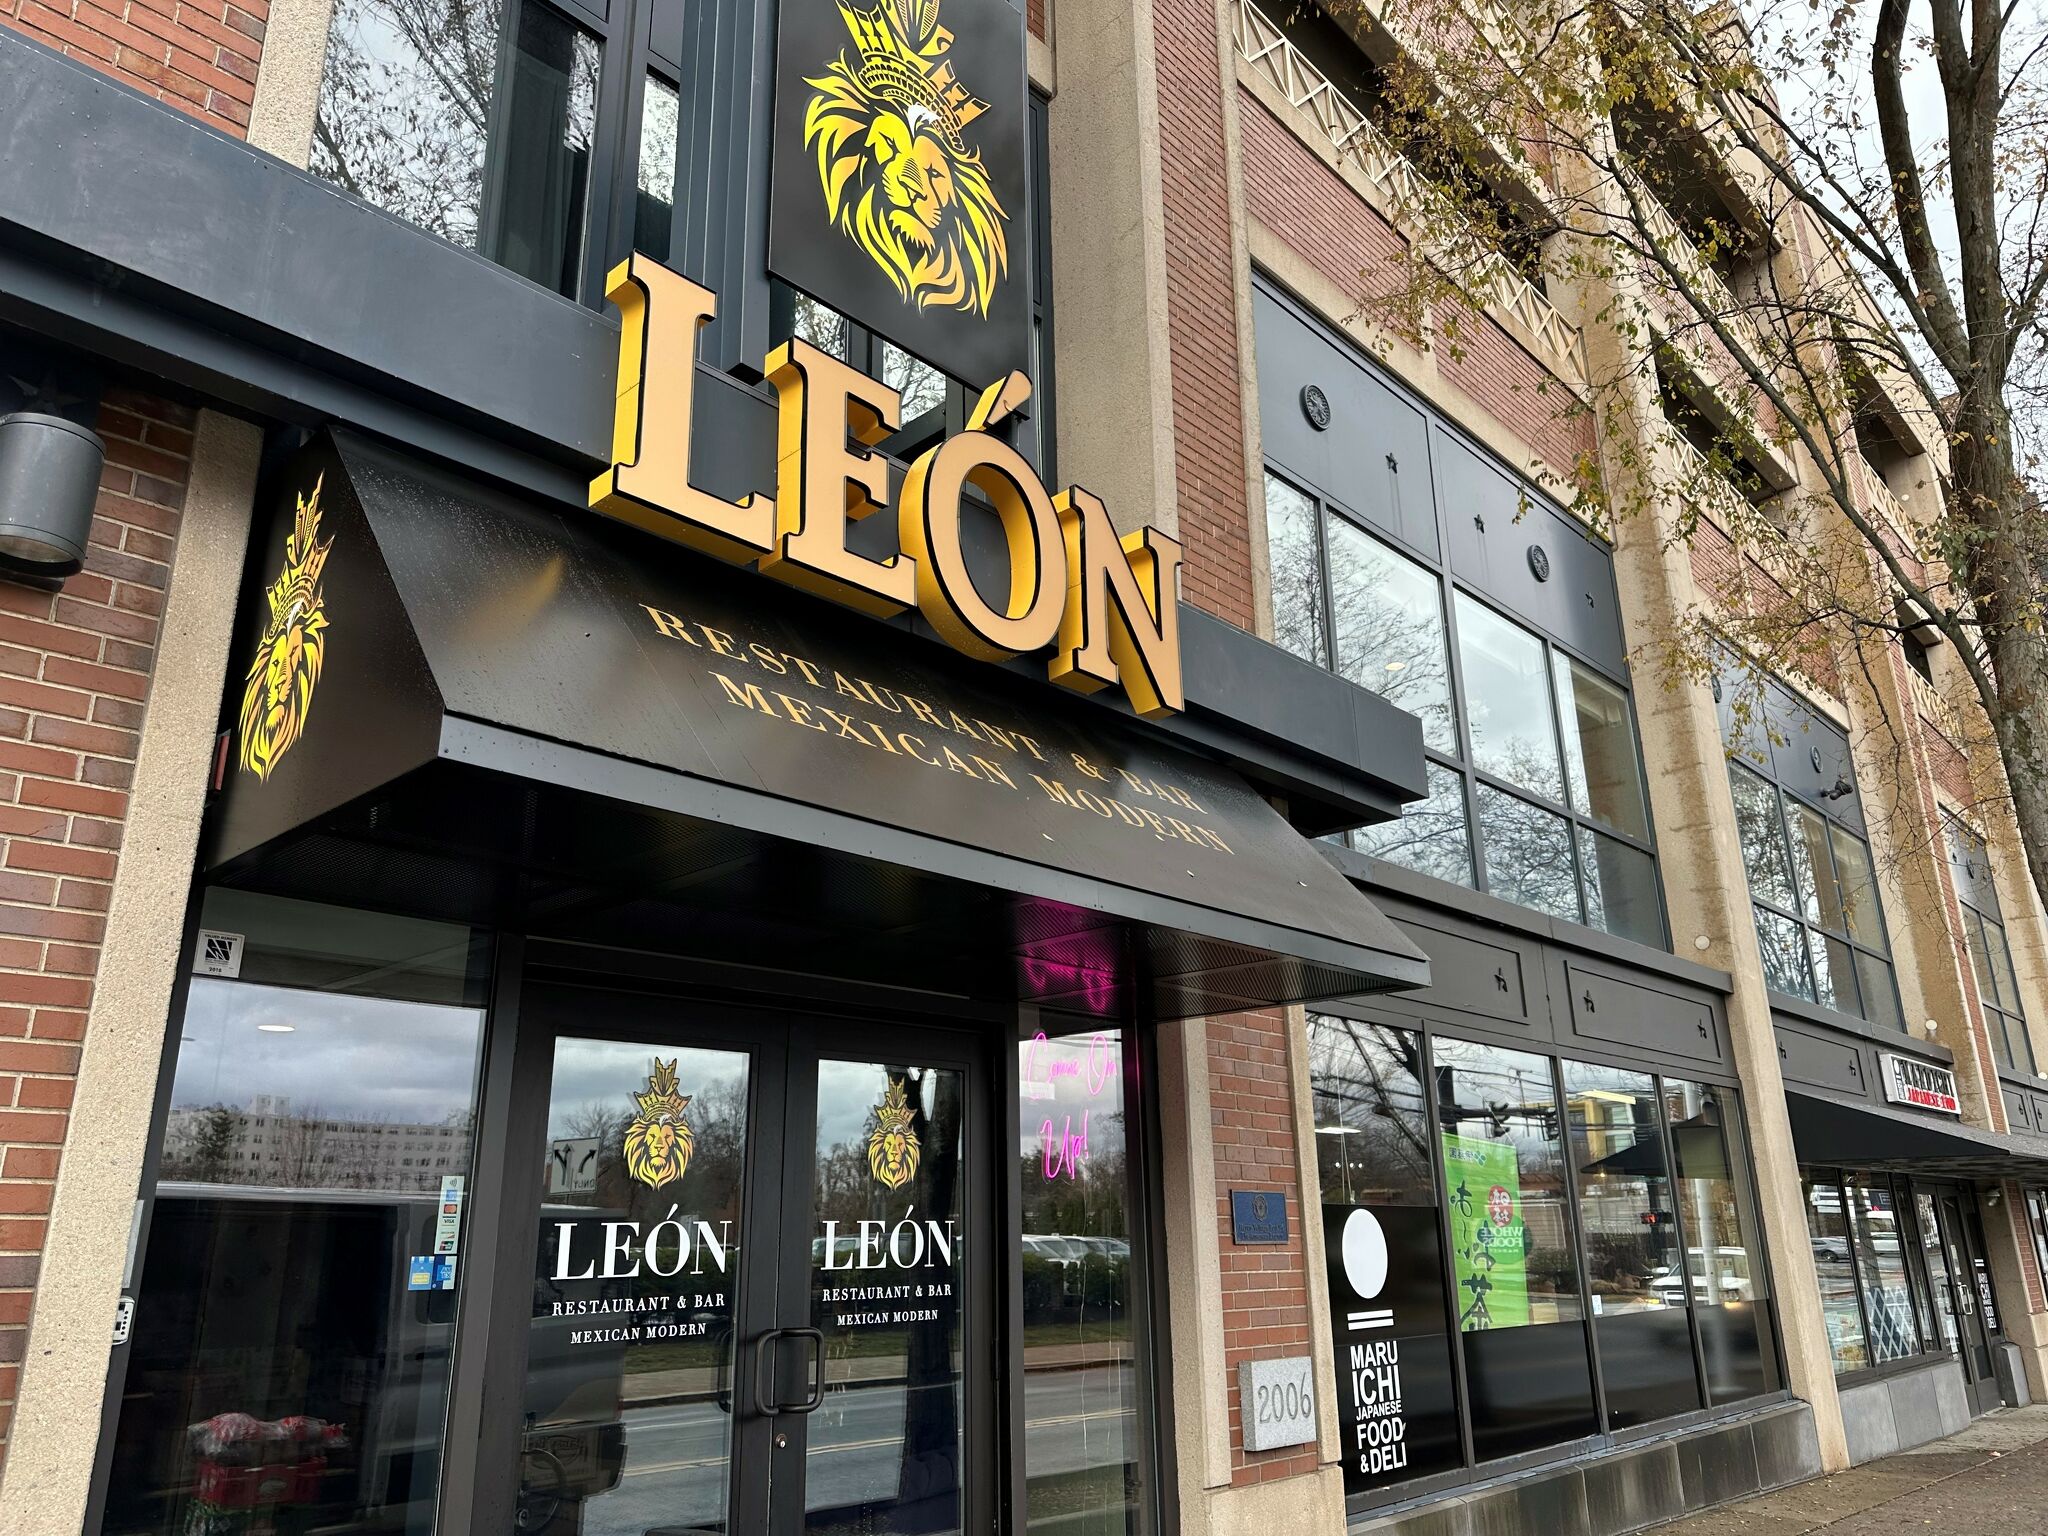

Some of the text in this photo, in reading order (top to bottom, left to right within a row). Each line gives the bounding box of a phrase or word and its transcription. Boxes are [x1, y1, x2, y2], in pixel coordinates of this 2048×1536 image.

[590, 250, 1184, 719] LEÓN
[638, 602, 1208, 815] RESTAURANT & BAR
[707, 670, 1236, 856] MEXICAN MODERN
[550, 1203, 733, 1281] LEÓN
[820, 1204, 955, 1271] LEÓN
[552, 1293, 726, 1317] RESTAURANT & BAR
[822, 1284, 953, 1302] RESTAURANT & BAR
[570, 1322, 707, 1344] MEXICAN MODERN
[837, 1309, 939, 1326] MEXICAN MODERN
[1349, 1340, 1399, 1370] MARU
[1257, 1371, 1312, 1425] 2006
[1351, 1364, 1402, 1408] ICHI
[1356, 1400, 1403, 1421] JAPANESE
[1356, 1416, 1405, 1450] FOOD
